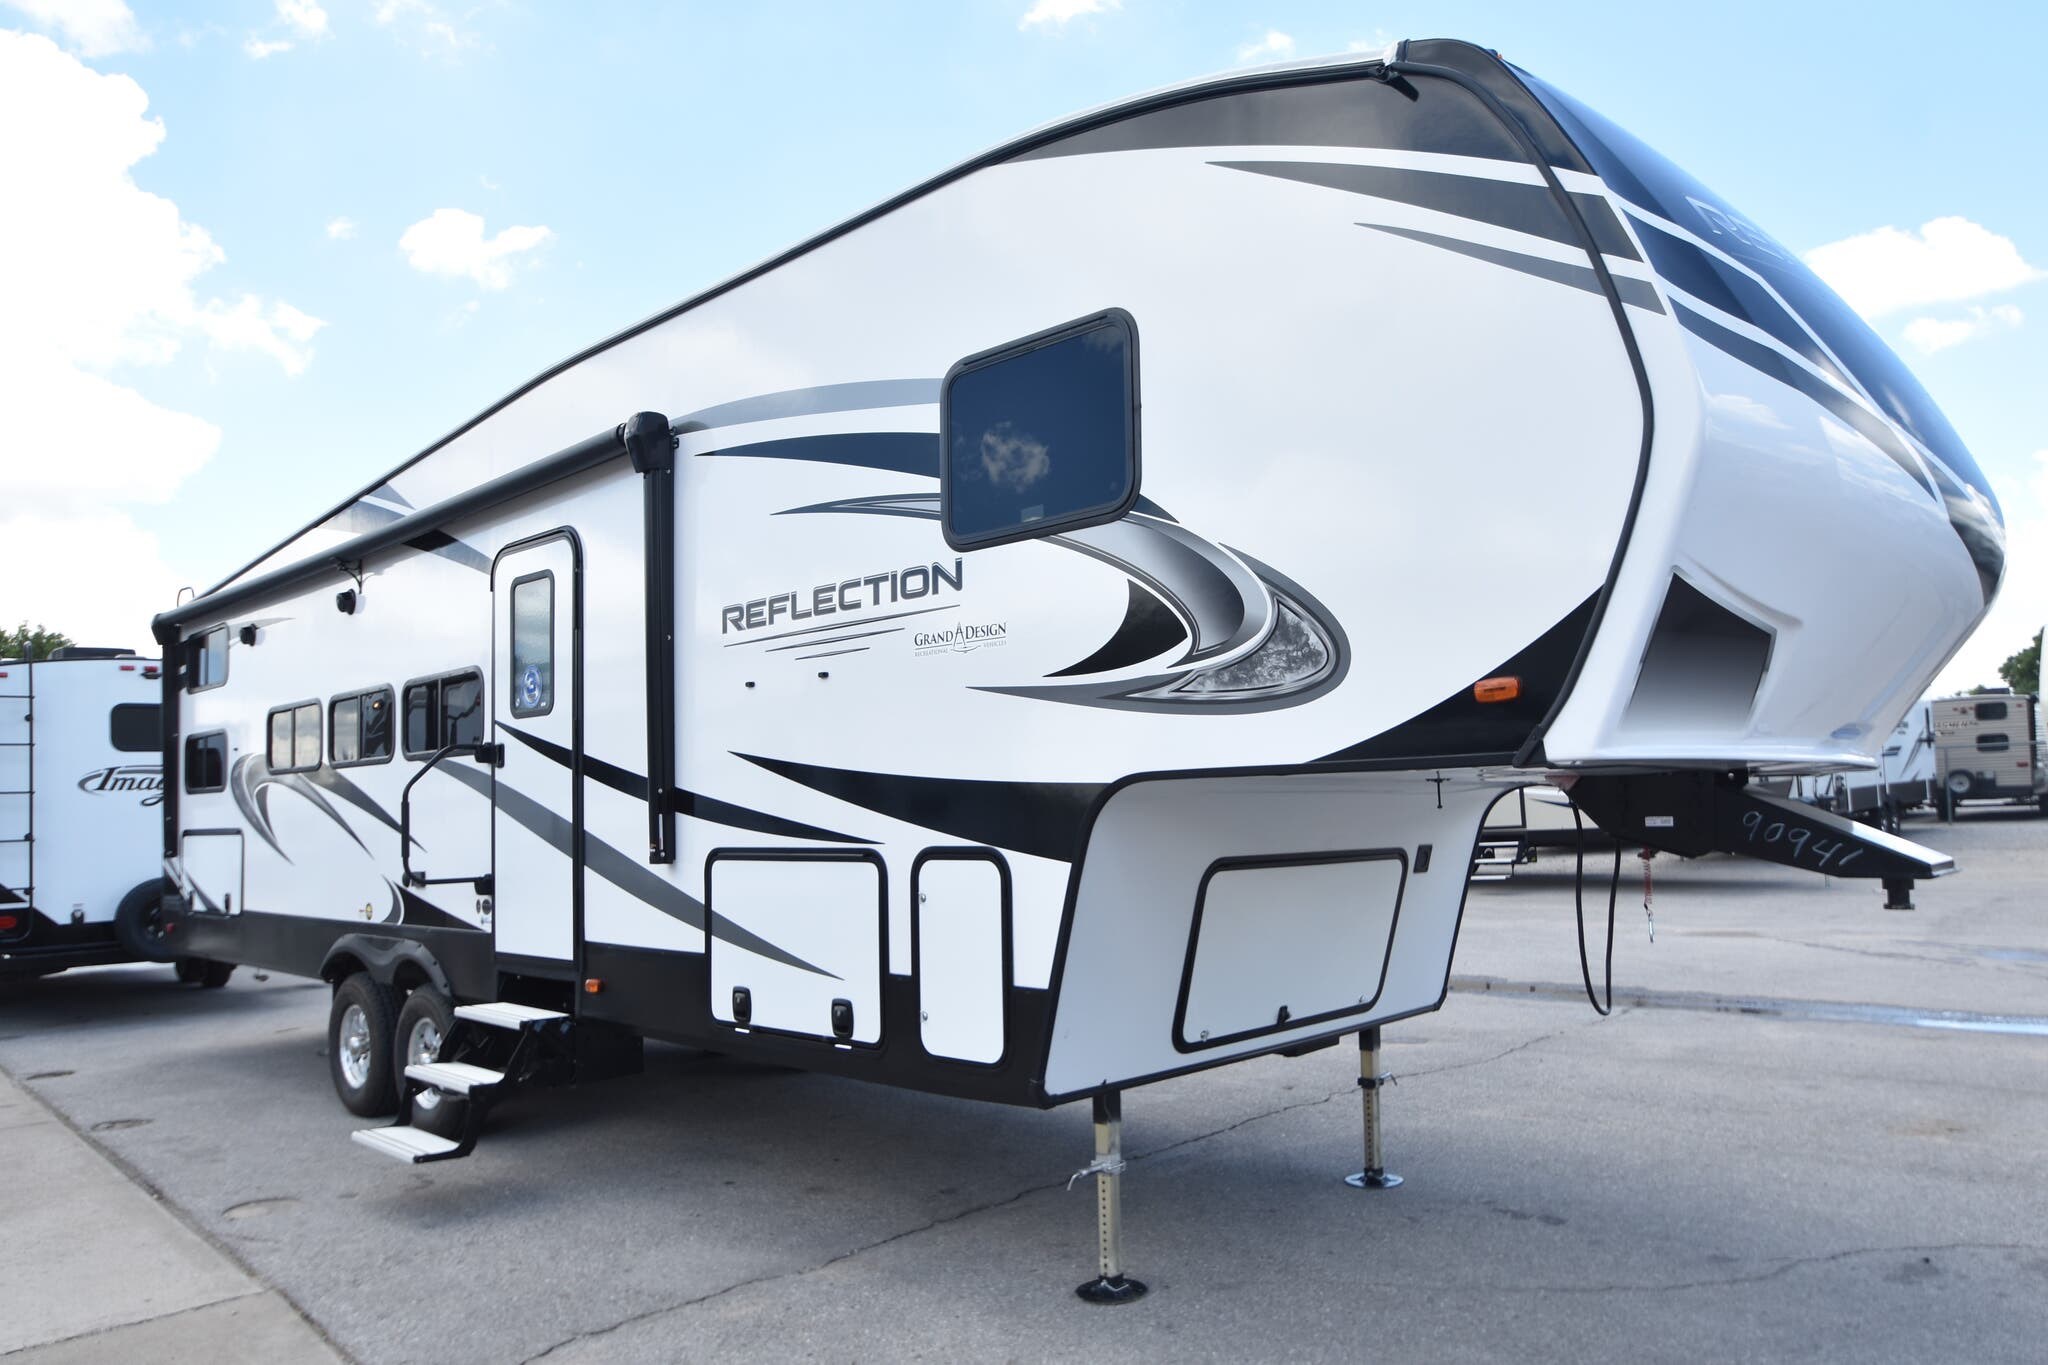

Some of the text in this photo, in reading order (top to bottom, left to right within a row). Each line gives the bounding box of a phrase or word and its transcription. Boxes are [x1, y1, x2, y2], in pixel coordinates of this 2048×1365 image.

[722, 557, 962, 634] REFLECTION
[914, 622, 1006, 646] GRAND DESIGN
